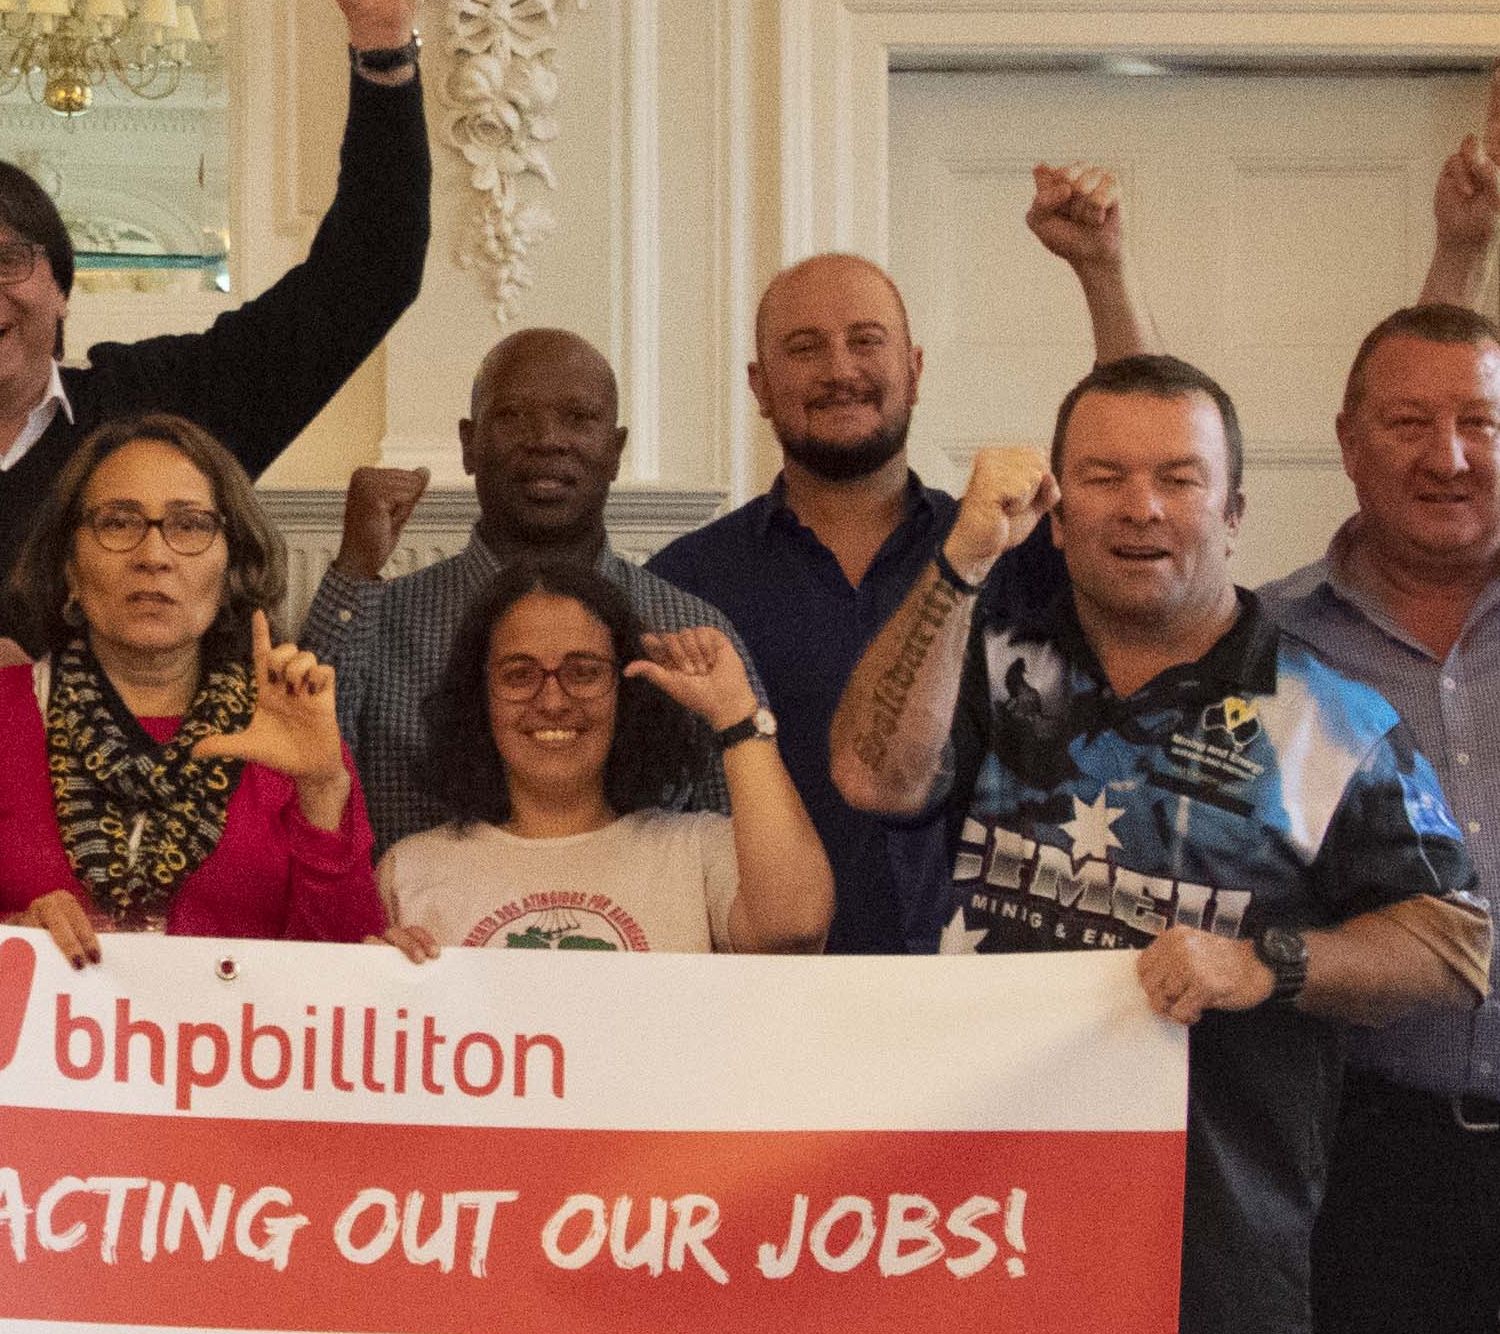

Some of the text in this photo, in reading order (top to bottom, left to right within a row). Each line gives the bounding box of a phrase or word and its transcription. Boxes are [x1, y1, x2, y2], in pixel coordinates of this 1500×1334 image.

[54, 993, 566, 1110] bhpbilliton
[334, 1188, 518, 1278] OUT
[542, 1193, 729, 1284] OUR
[756, 1188, 1027, 1279] JOBS!
